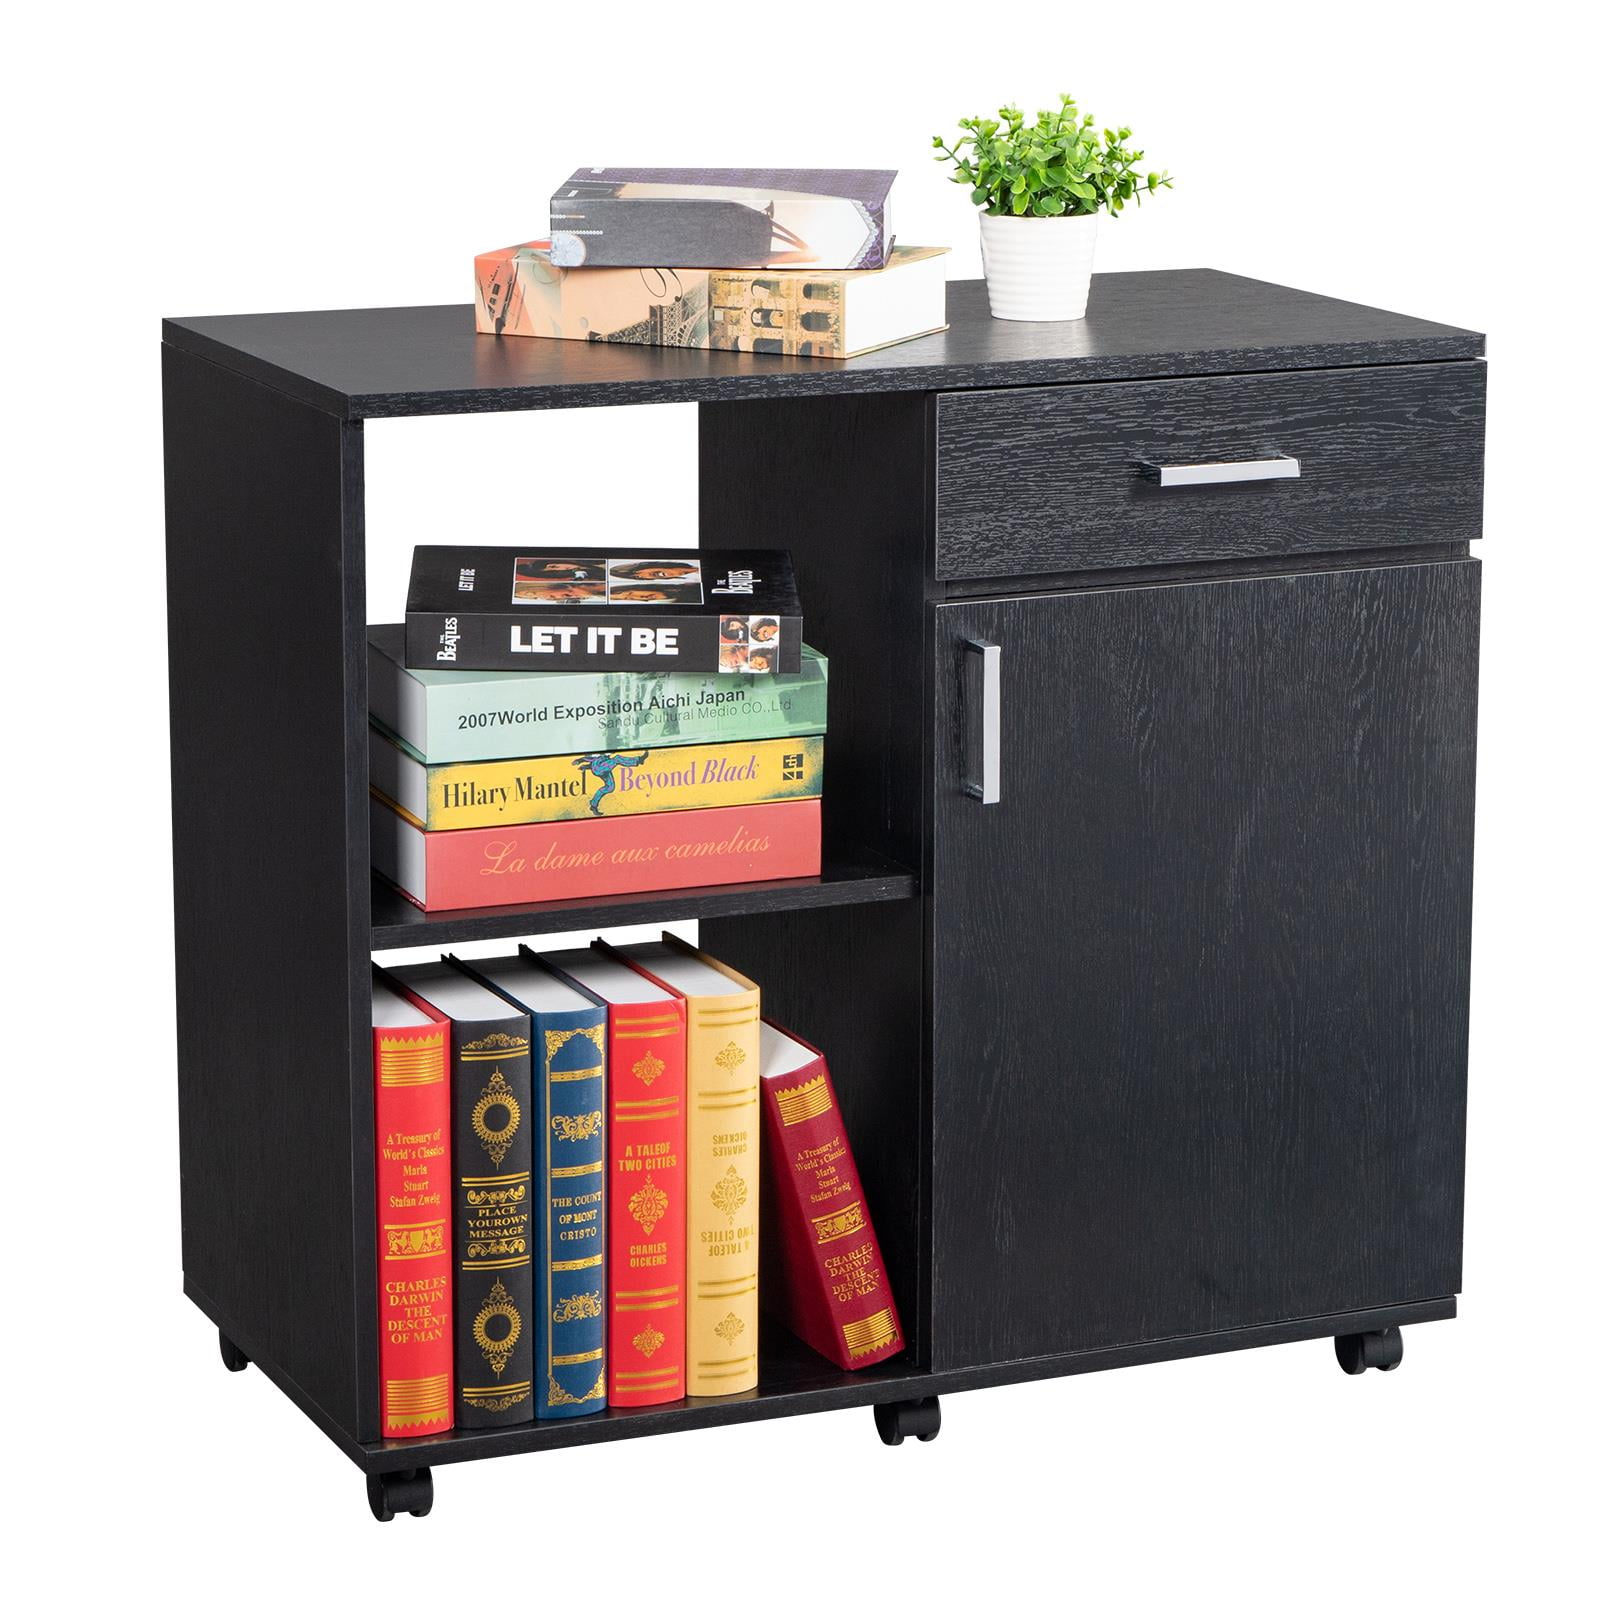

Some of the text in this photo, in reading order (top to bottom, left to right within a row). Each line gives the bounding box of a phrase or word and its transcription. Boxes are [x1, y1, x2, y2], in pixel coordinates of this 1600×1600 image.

[711, 570, 761, 594] BEATLES
[437, 617, 460, 662] BEATLES
[511, 625, 679, 656] LET IT BE
[458, 689, 745, 730] 2007World Exposition Aichi Japan
[598, 712, 641, 730] Sandu
[644, 709, 694, 725] Cultural
[698, 705, 738, 719] Medio
[443, 755, 759, 811] Hilary Mantel Beyond Black
[480, 825, 770, 876] La dame aux camelias
[387, 1128, 442, 1145] A Treasury of
[712, 1132, 747, 1144] DICKENS
[418, 1145, 445, 1158] Classics
[626, 1142, 670, 1157] A TALEOF
[797, 1152, 803, 1161] A
[618, 1154, 677, 1172] TWO CITIES
[404, 1180, 429, 1192] Stuart
[552, 1191, 602, 1208] THE COUNT
[478, 1206, 516, 1216] PLACE
[559, 1209, 598, 1224] OF MONT
[467, 1214, 528, 1228] YOUROWN
[469, 1226, 524, 1238] MESSAGE
[560, 1226, 597, 1240] CRISTO
[701, 1228, 734, 1242] CITIES
[630, 1242, 667, 1256] CHARLES
[708, 1243, 742, 1257] TALEOF
[824, 1242, 873, 1268] CHARLES
[630, 1255, 667, 1268] DICKENS
[829, 1252, 874, 1278] DARWIN
[832, 1268, 880, 1296] DESCENT
[844, 1266, 866, 1282] THE
[386, 1276, 447, 1294] CHARLES
[838, 1281, 880, 1302] OF MAN
[389, 1288, 444, 1306] DARWIN
[404, 1305, 432, 1318] THE
[388, 1315, 448, 1332] DESCENT
[391, 1329, 443, 1345] OF MAN
